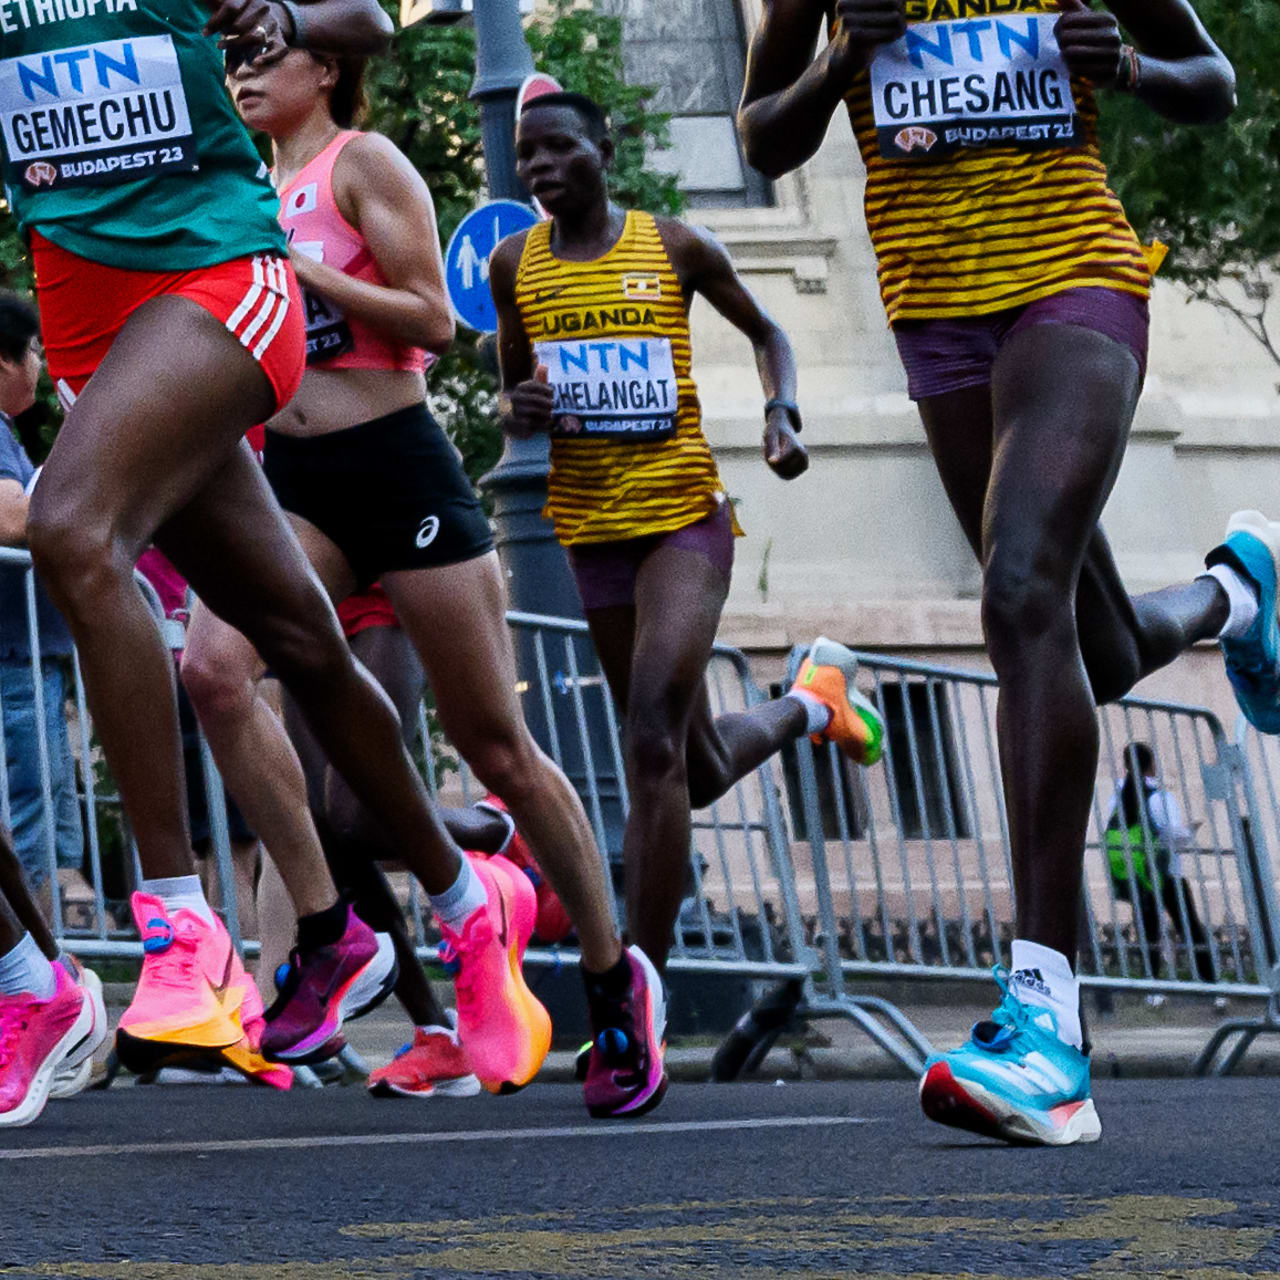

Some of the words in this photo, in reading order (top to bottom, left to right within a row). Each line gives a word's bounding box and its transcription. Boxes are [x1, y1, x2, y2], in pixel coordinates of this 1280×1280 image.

[904, 17, 1039, 70] NTN
[17, 43, 141, 102] NTN
[883, 69, 1063, 120] CHESANG
[11, 89, 177, 155] GEMECHU
[945, 124, 1051, 143] BUDAPEST
[60, 150, 158, 179] BUDAPEST
[160, 146, 184, 164] 23
[543, 307, 657, 335] UGANDA
[558, 341, 650, 375] NTN
[584, 418, 656, 433] BUDAPEST
